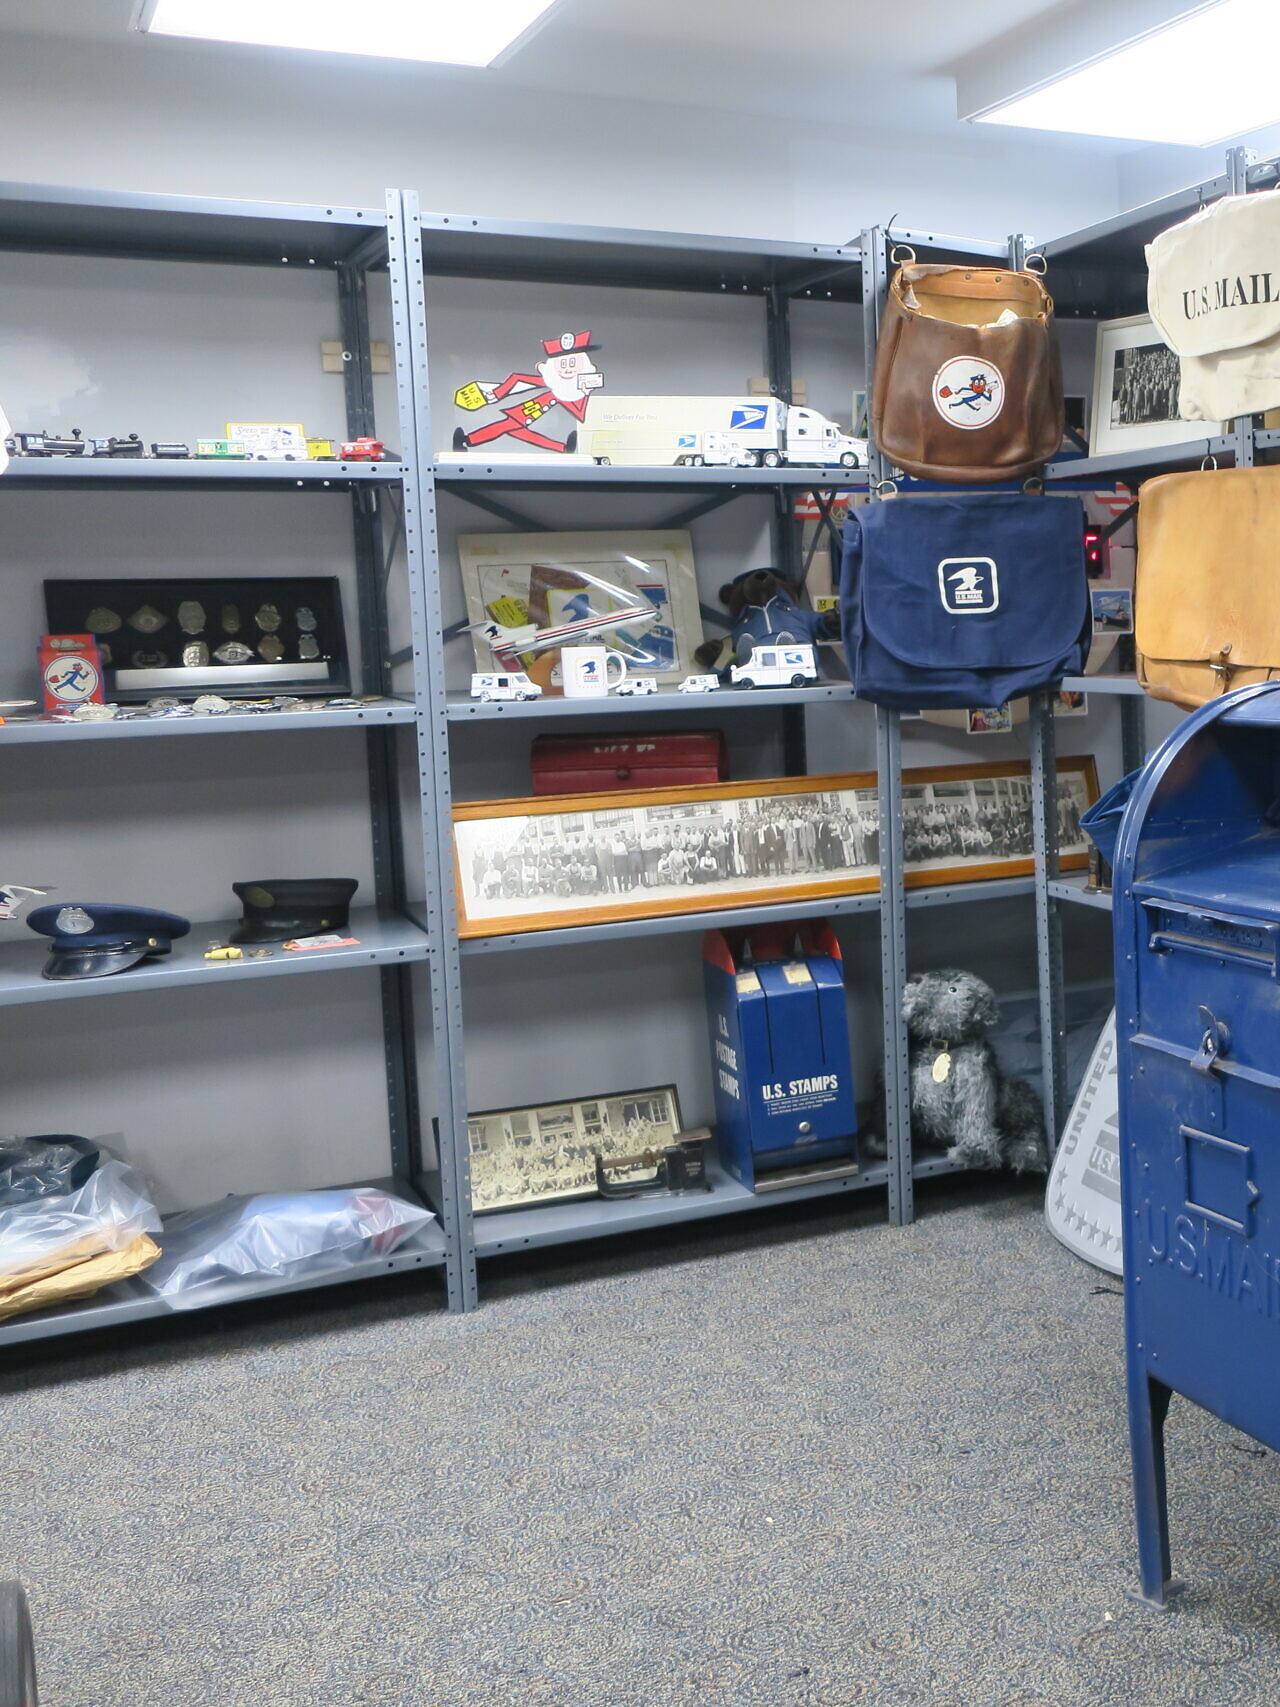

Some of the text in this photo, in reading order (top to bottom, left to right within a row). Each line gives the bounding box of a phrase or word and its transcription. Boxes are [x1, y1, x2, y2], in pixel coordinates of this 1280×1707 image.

[1214, 272, 1280, 311] MAIL
[718, 1068, 740, 1100] STAMPS
[762, 1074, 839, 1101] U.S. STAMPS
[1063, 1039, 1114, 1156] UNITED
